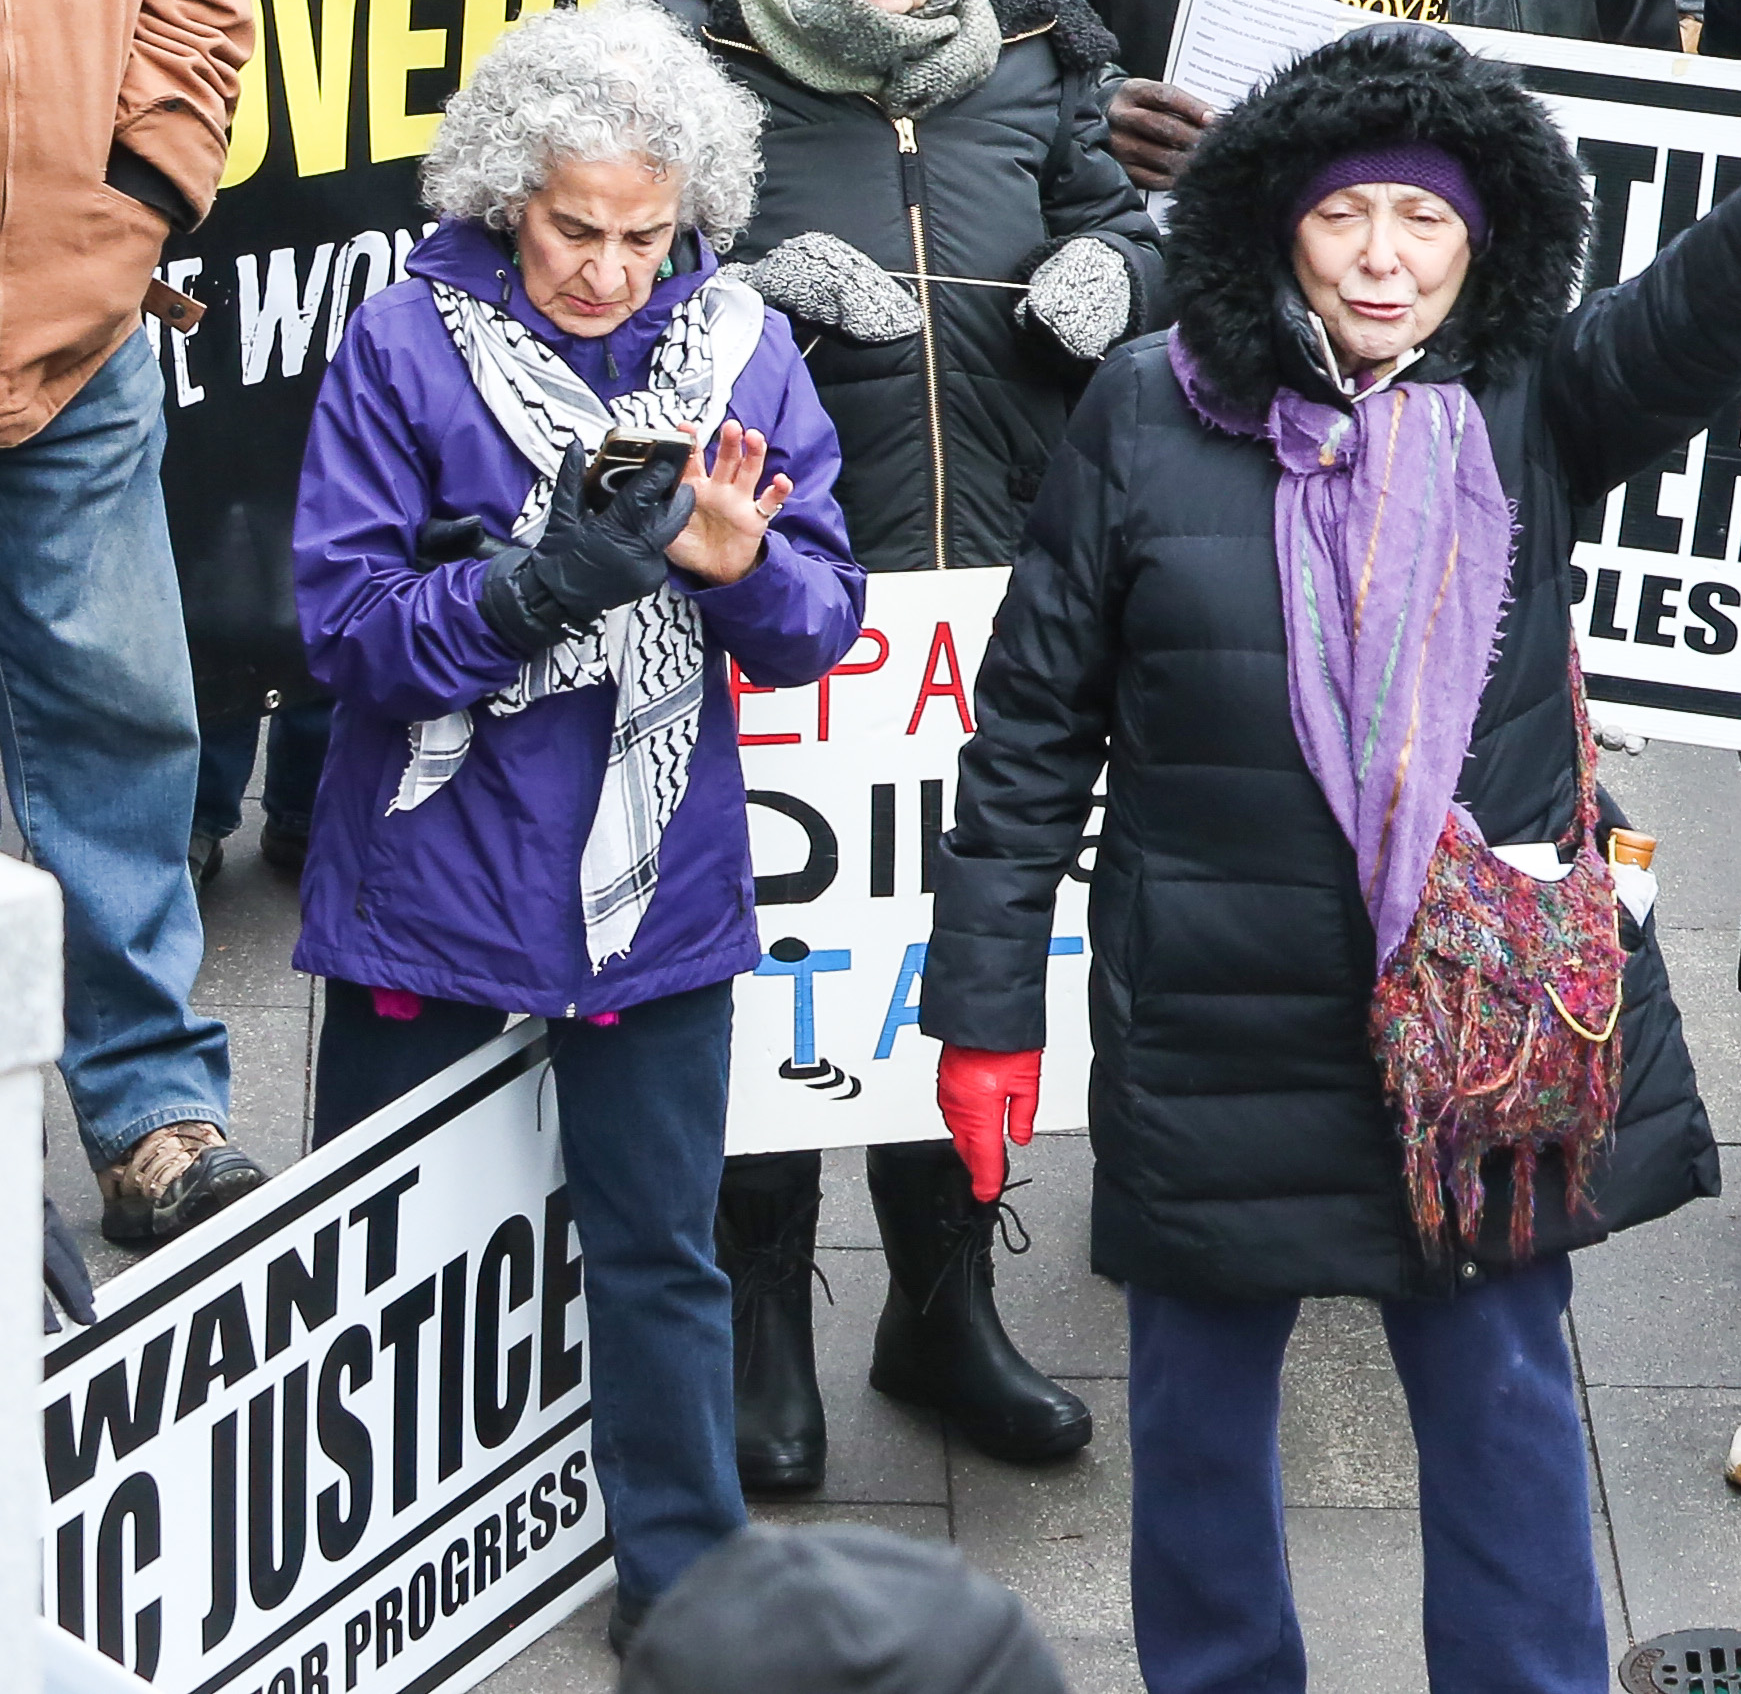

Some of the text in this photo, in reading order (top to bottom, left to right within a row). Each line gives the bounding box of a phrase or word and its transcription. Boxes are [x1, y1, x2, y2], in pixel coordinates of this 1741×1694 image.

[42, 1164, 422, 1505] WANT
[202, 1182, 584, 1656] JUSTICE
[344, 1449, 590, 1693] PROGRESS
